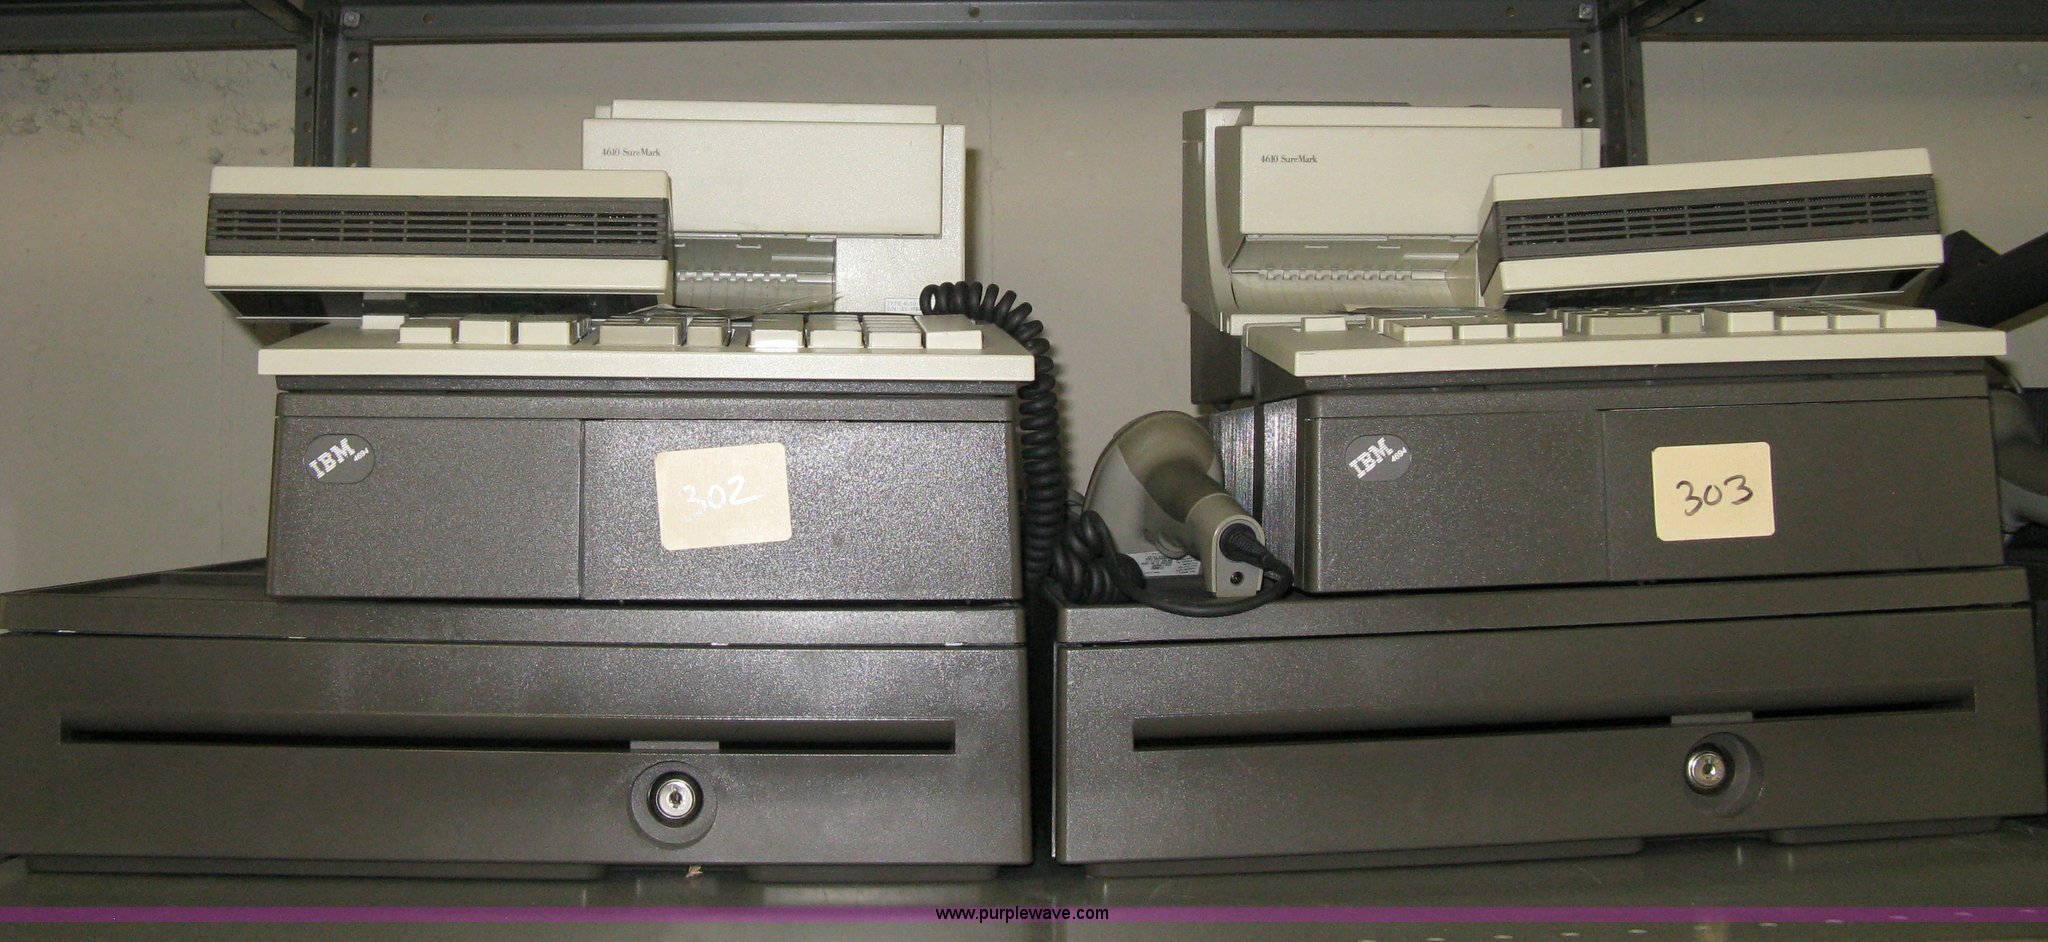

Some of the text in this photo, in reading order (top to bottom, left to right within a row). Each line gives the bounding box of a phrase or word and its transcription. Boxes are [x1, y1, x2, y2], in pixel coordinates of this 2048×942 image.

[602, 147, 620, 157] 4610
[1261, 154, 1318, 163] 4610 SureMark
[308, 437, 369, 479] IBM 4694
[1348, 437, 1407, 479] IBM 4694
[678, 474, 764, 523] 302
[1675, 474, 1754, 517] 303
